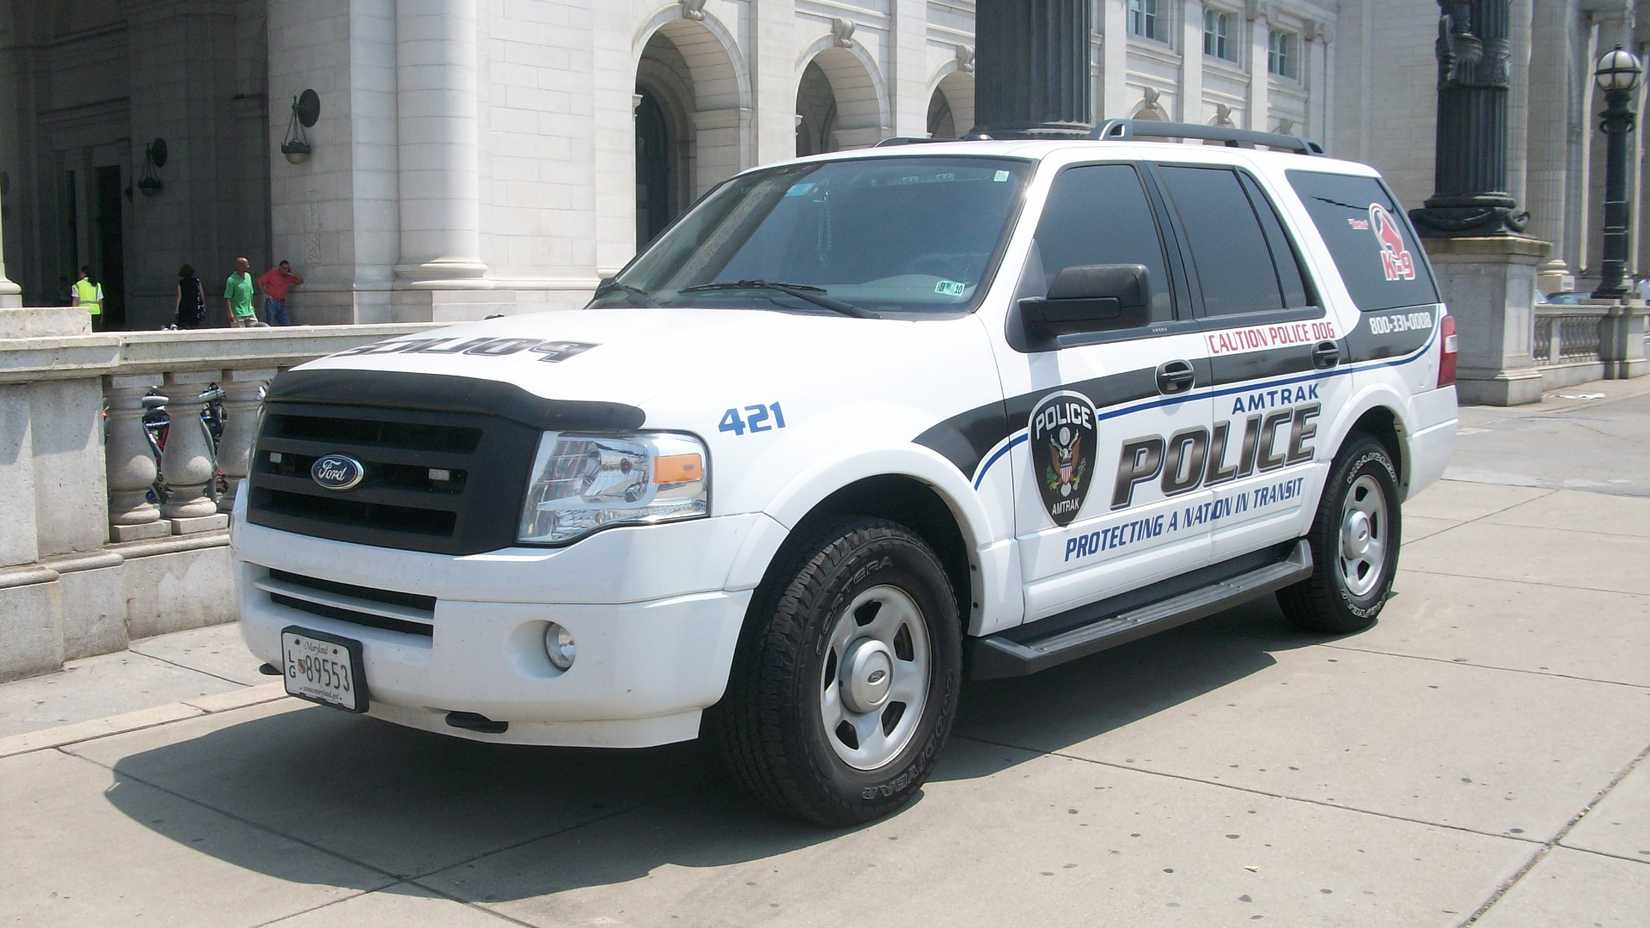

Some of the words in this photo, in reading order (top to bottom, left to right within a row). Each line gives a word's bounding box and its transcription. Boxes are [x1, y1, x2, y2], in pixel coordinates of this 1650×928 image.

[1208, 327, 1268, 354] CAUTION
[1271, 324, 1310, 345] POLICE
[1314, 321, 1336, 340] DOG
[1232, 383, 1320, 415] AMTRAK
[718, 401, 786, 436] 421
[1034, 402, 1092, 440] POLICE
[318, 459, 347, 481] Ford
[1110, 400, 1321, 511] POLICE
[1051, 499, 1080, 515] AMTRAK
[1065, 514, 1164, 561] PROTECTING
[1167, 511, 1178, 534] A
[1183, 496, 1232, 529] NATION
[1235, 495, 1250, 513] IN
[1253, 478, 1304, 509] TRANSIT
[305, 654, 350, 692] 89553
